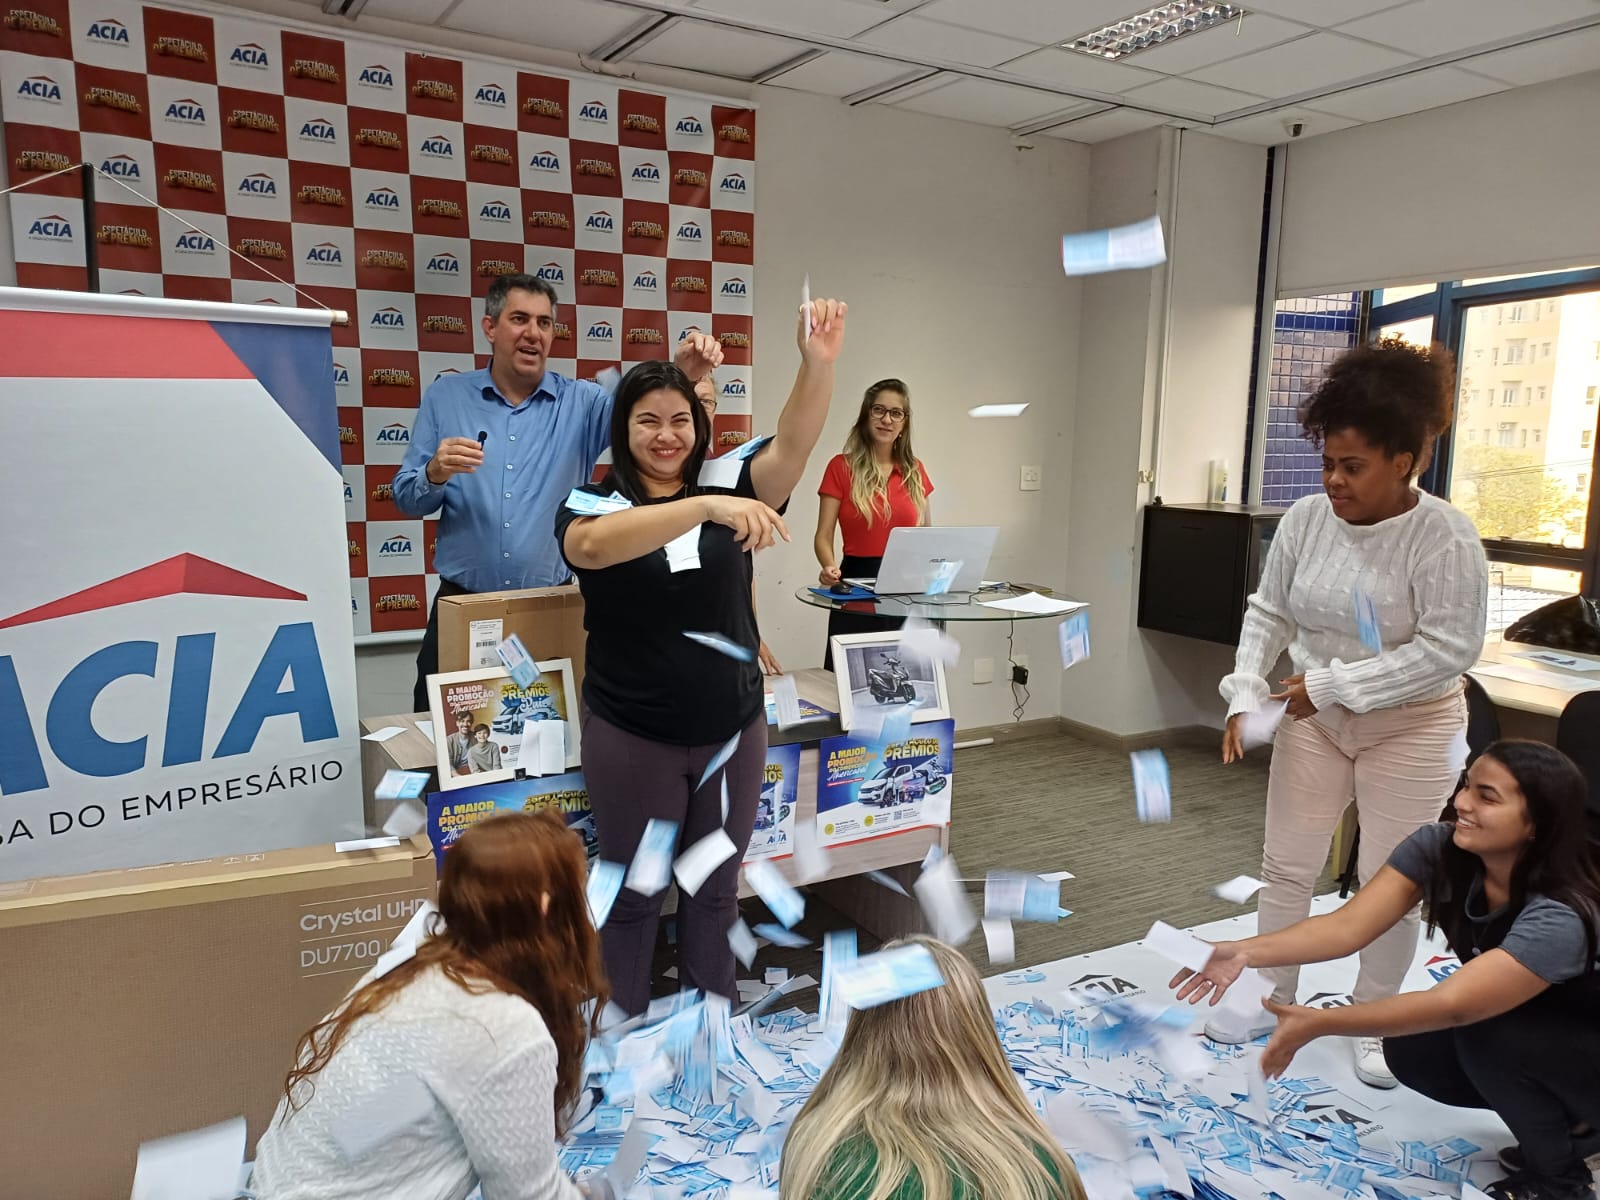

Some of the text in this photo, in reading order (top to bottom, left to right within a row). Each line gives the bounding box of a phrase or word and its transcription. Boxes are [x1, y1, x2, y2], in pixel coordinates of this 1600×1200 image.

[87, 24, 129, 42] ACIA
[230, 48, 269, 66] ACIA
[358, 69, 394, 86] ACIA
[18, 81, 61, 100] ACIA
[474, 88, 506, 104] ACIA
[165, 104, 206, 122] ACIA
[579, 105, 608, 120] ACIA
[300, 124, 336, 139] ACIA
[676, 121, 703, 133] ACIA
[420, 140, 453, 156] ACIA
[100, 161, 140, 177] ACIA
[530, 156, 560, 170] ACIA
[632, 168, 660, 179] ACIA
[239, 178, 276, 194] ACIA
[720, 178, 746, 190] ACIA
[366, 193, 399, 207] ACIA
[480, 206, 511, 219] ACIA
[29, 221, 72, 238] ACIA
[586, 216, 613, 229] ACIA
[677, 227, 701, 239] ACIA
[175, 236, 215, 251] ACIA
[306, 248, 342, 263] ACIA
[426, 258, 459, 272] ACIA
[536, 268, 564, 281] ACIA
[633, 276, 657, 288] ACIA
[720, 283, 746, 294] ACIA
[371, 313, 404, 326] ACIA
[587, 326, 613, 338] ACIA
[723, 384, 746, 395] ACIA
[377, 430, 410, 441] ACIA
[380, 541, 412, 553] ACIA
[456, 684, 482, 694] MAIOR
[838, 747, 866, 757] MAIOR
[49, 805, 105, 835] DO
[121, 760, 343, 821] EMPRESÁRIO
[442, 801, 494, 815] A MAIOR
[300, 904, 381, 933] Crystal
[300, 940, 380, 967] DU7700
